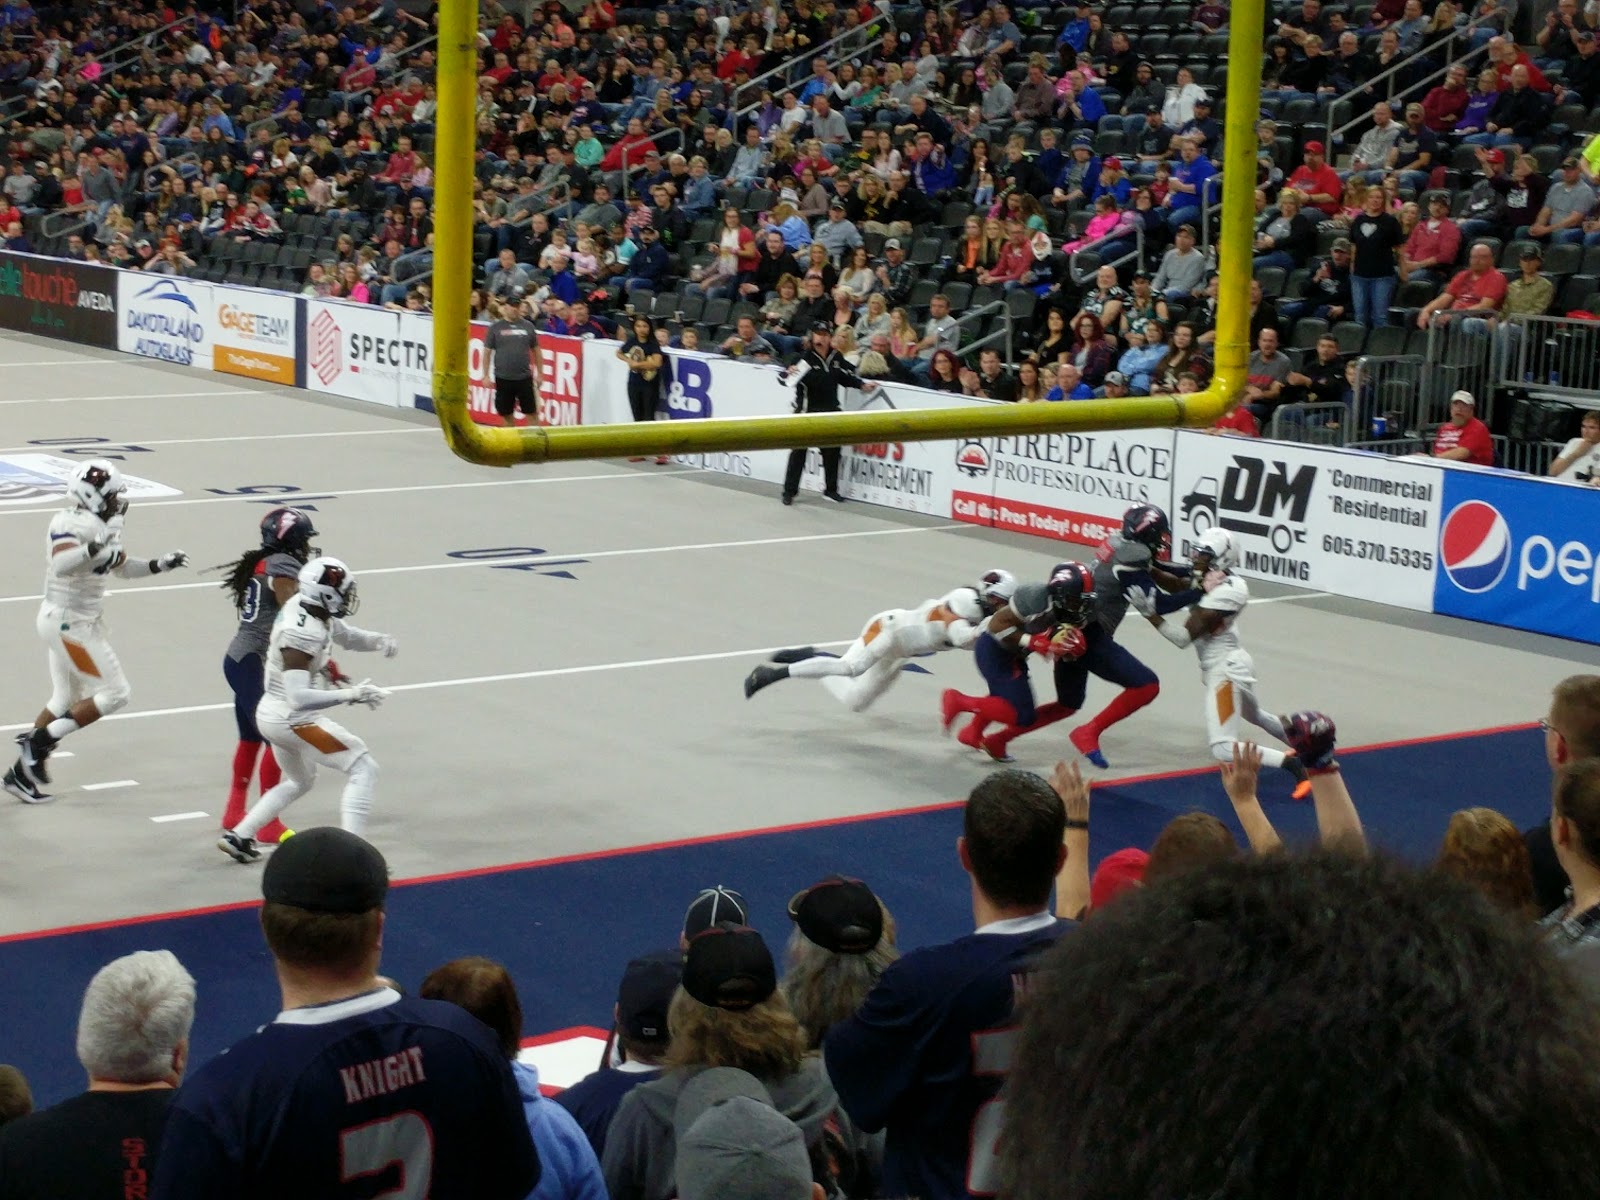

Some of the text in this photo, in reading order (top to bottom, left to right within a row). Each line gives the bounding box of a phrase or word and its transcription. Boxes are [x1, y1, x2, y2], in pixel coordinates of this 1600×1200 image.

[77, 289, 115, 313] AVEDA
[127, 308, 205, 343] DAKOTALAND
[135, 336, 193, 366] AUTOGLASS
[994, 433, 1171, 482] FIREPLACE
[993, 458, 1150, 501] PROFESSIONALS
[1219, 454, 1318, 523] DM
[953, 497, 976, 517] Call
[1001, 506, 1028, 527] Pros
[1029, 512, 1071, 536] Today!
[1244, 550, 1310, 582] MOVING
[1322, 533, 1433, 571] 605.370.5335
[339, 1045, 427, 1103] KNIGHT
